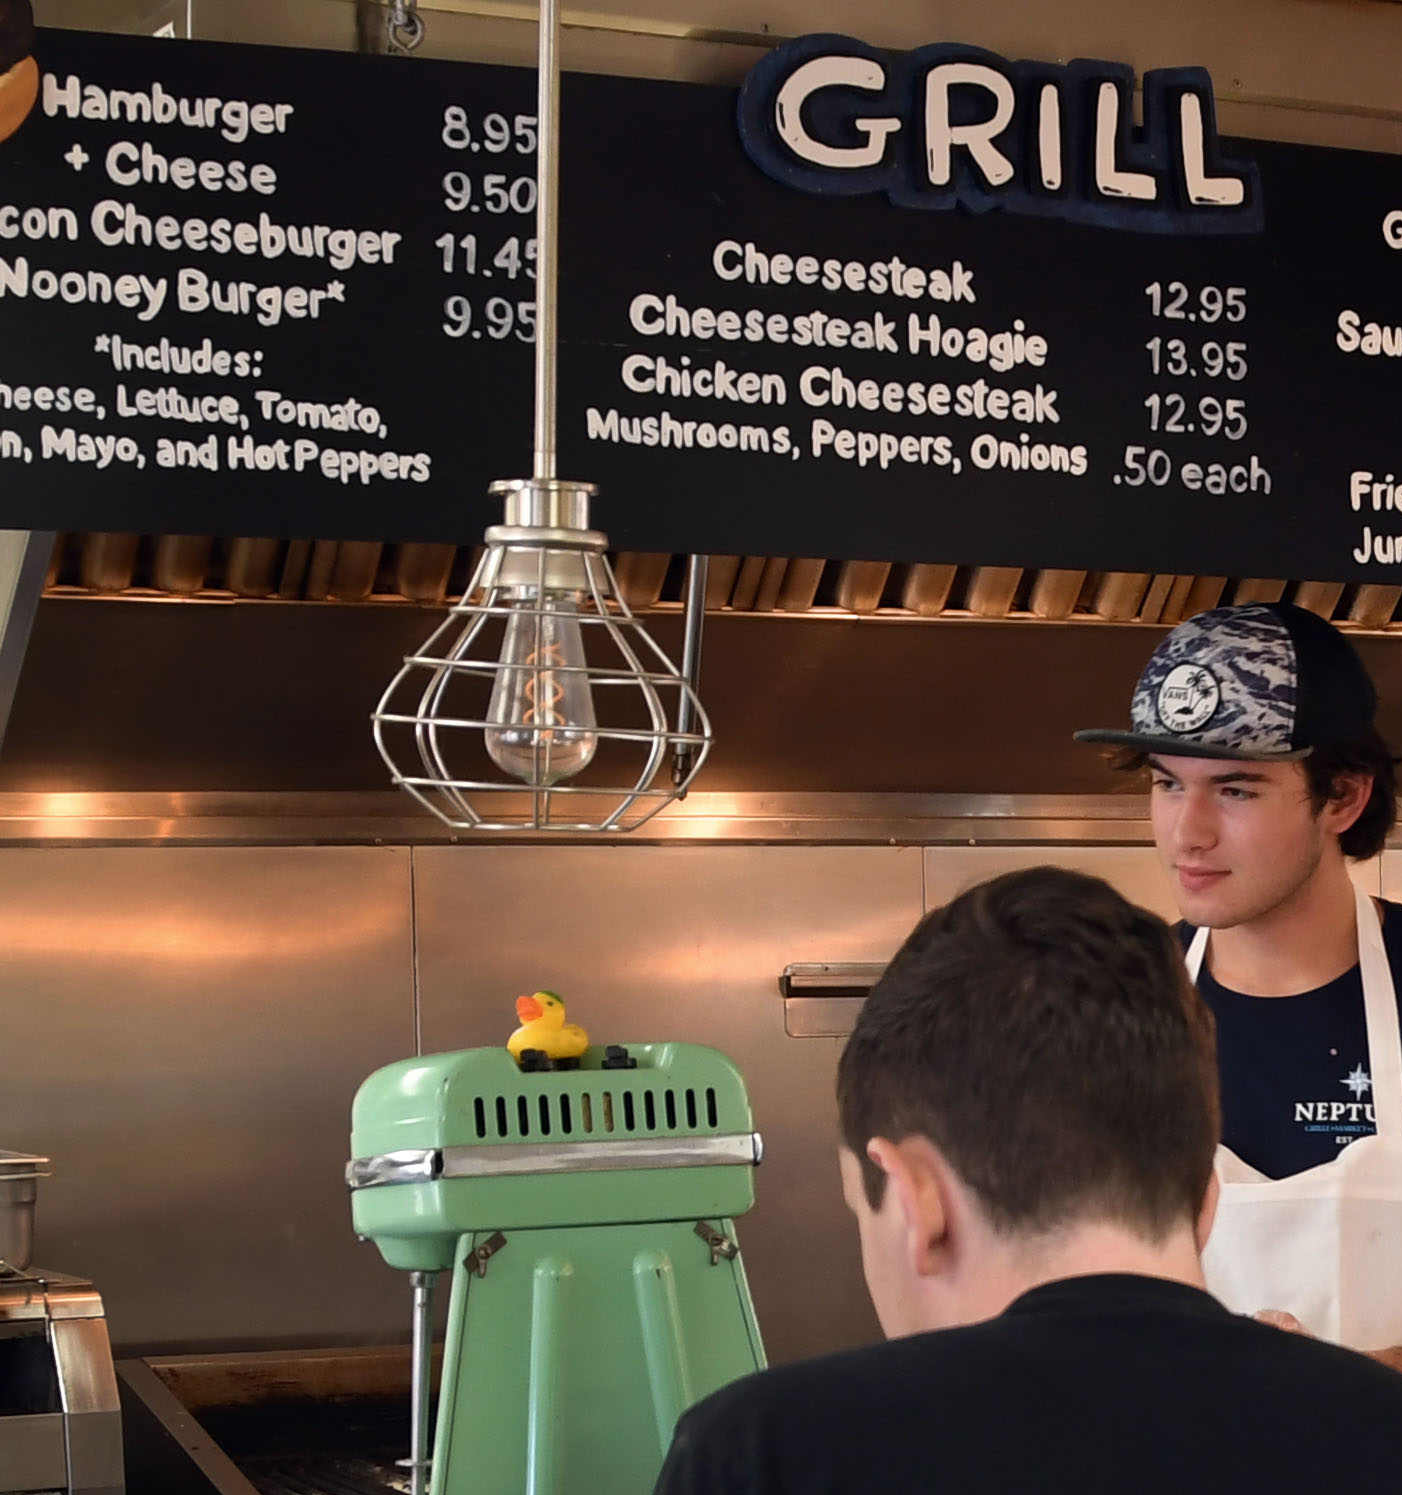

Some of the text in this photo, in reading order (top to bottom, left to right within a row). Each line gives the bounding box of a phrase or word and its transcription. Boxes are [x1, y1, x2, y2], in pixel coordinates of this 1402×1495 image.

[42, 73, 537, 153] Hamburger 8.95
[775, 55, 1244, 206] GRILL
[63, 141, 537, 214] + Cheese 9.50
[90, 199, 402, 271] Cheeseburger
[434, 232, 537, 279] 11.45
[0, 256, 168, 322] Nooney
[442, 295, 536, 343] 9.95
[712, 240, 1247, 323] Cheesesteak 12.95
[629, 293, 1248, 381] Cheesesteak Hoagie 13.95
[116, 384, 388, 439] Lettuce, Tomato,
[621, 354, 1248, 441] Chicken Cheesesteak 12.95
[40, 424, 146, 470] Mayo,
[155, 434, 219, 472] and
[227, 434, 292, 471] Hot
[293, 438, 432, 485] Peppers
[586, 407, 1272, 495] Mushrooms, Peppers, Onions .50 each
